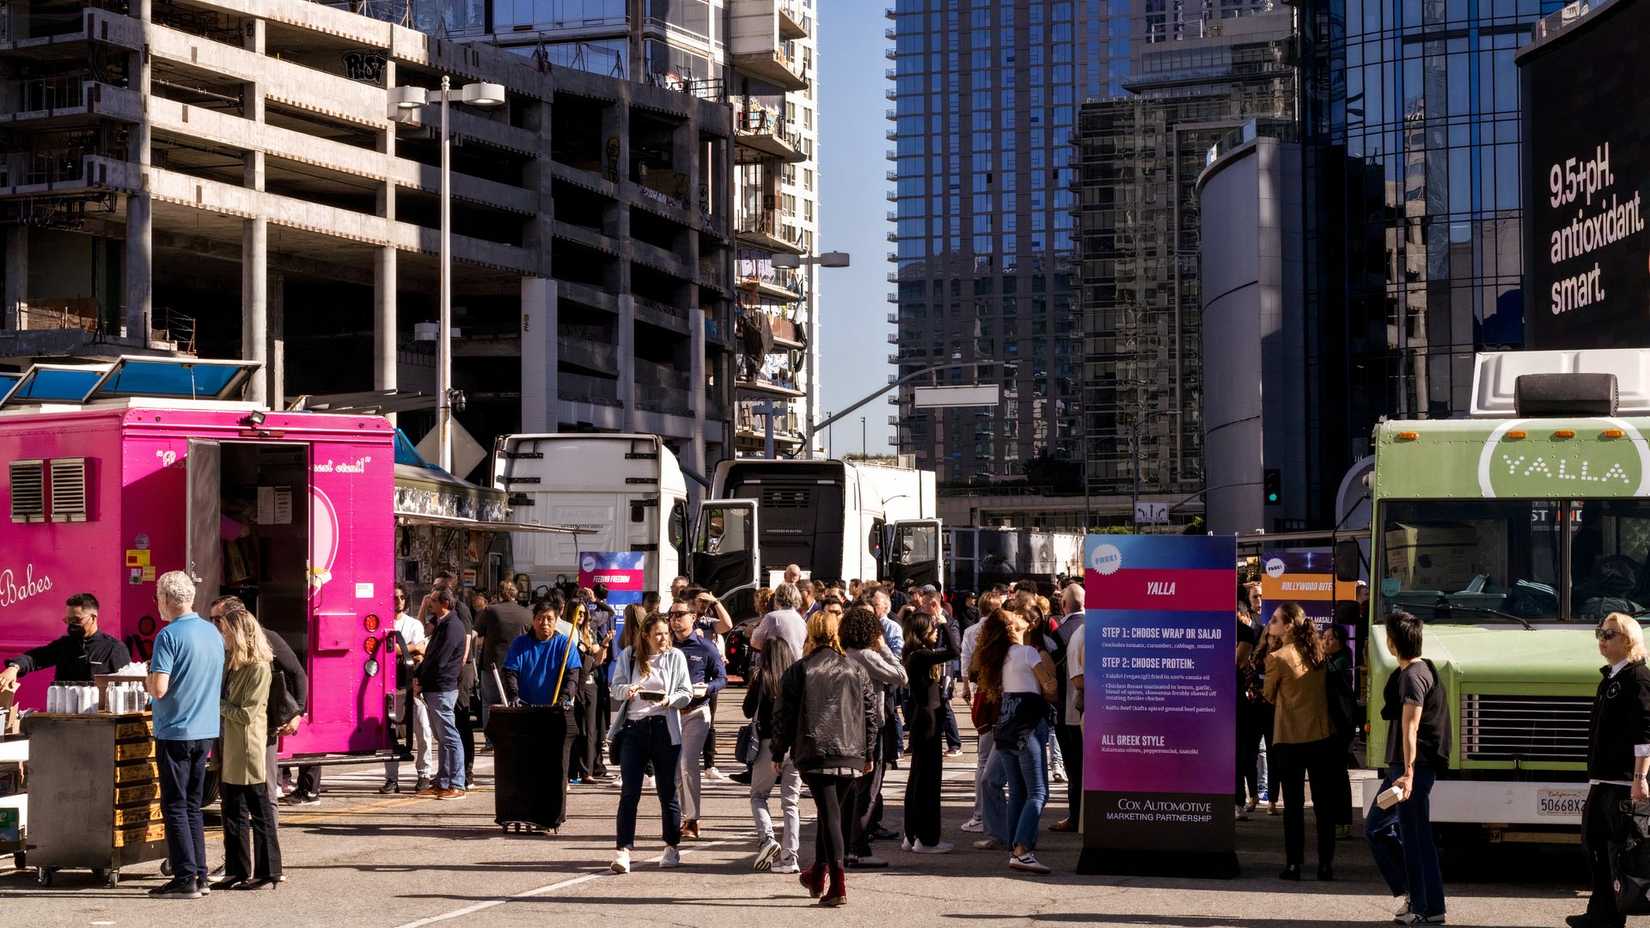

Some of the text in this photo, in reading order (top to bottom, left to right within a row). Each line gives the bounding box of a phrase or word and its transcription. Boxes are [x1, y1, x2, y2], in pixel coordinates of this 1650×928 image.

[1550, 141, 1614, 208] 9.5+pH.
[1551, 190, 1645, 264] antioxidant.
[1551, 262, 1605, 315] smart.
[1503, 454, 1630, 484] YALLA
[0, 563, 53, 607] Babes
[1147, 581, 1176, 596] YALLA
[1102, 627, 1222, 640] STEP 1: CHOOSE WRAP OR SALAD
[1102, 657, 1195, 669] STEP 2: CHOOSE PROTEIN:
[1102, 735, 1165, 747] ALL GREEK STYLE
[1118, 799, 1212, 813] COX AUTOMOTIVE
[1106, 812, 1212, 823] MARKETING PARTNERSHIP
